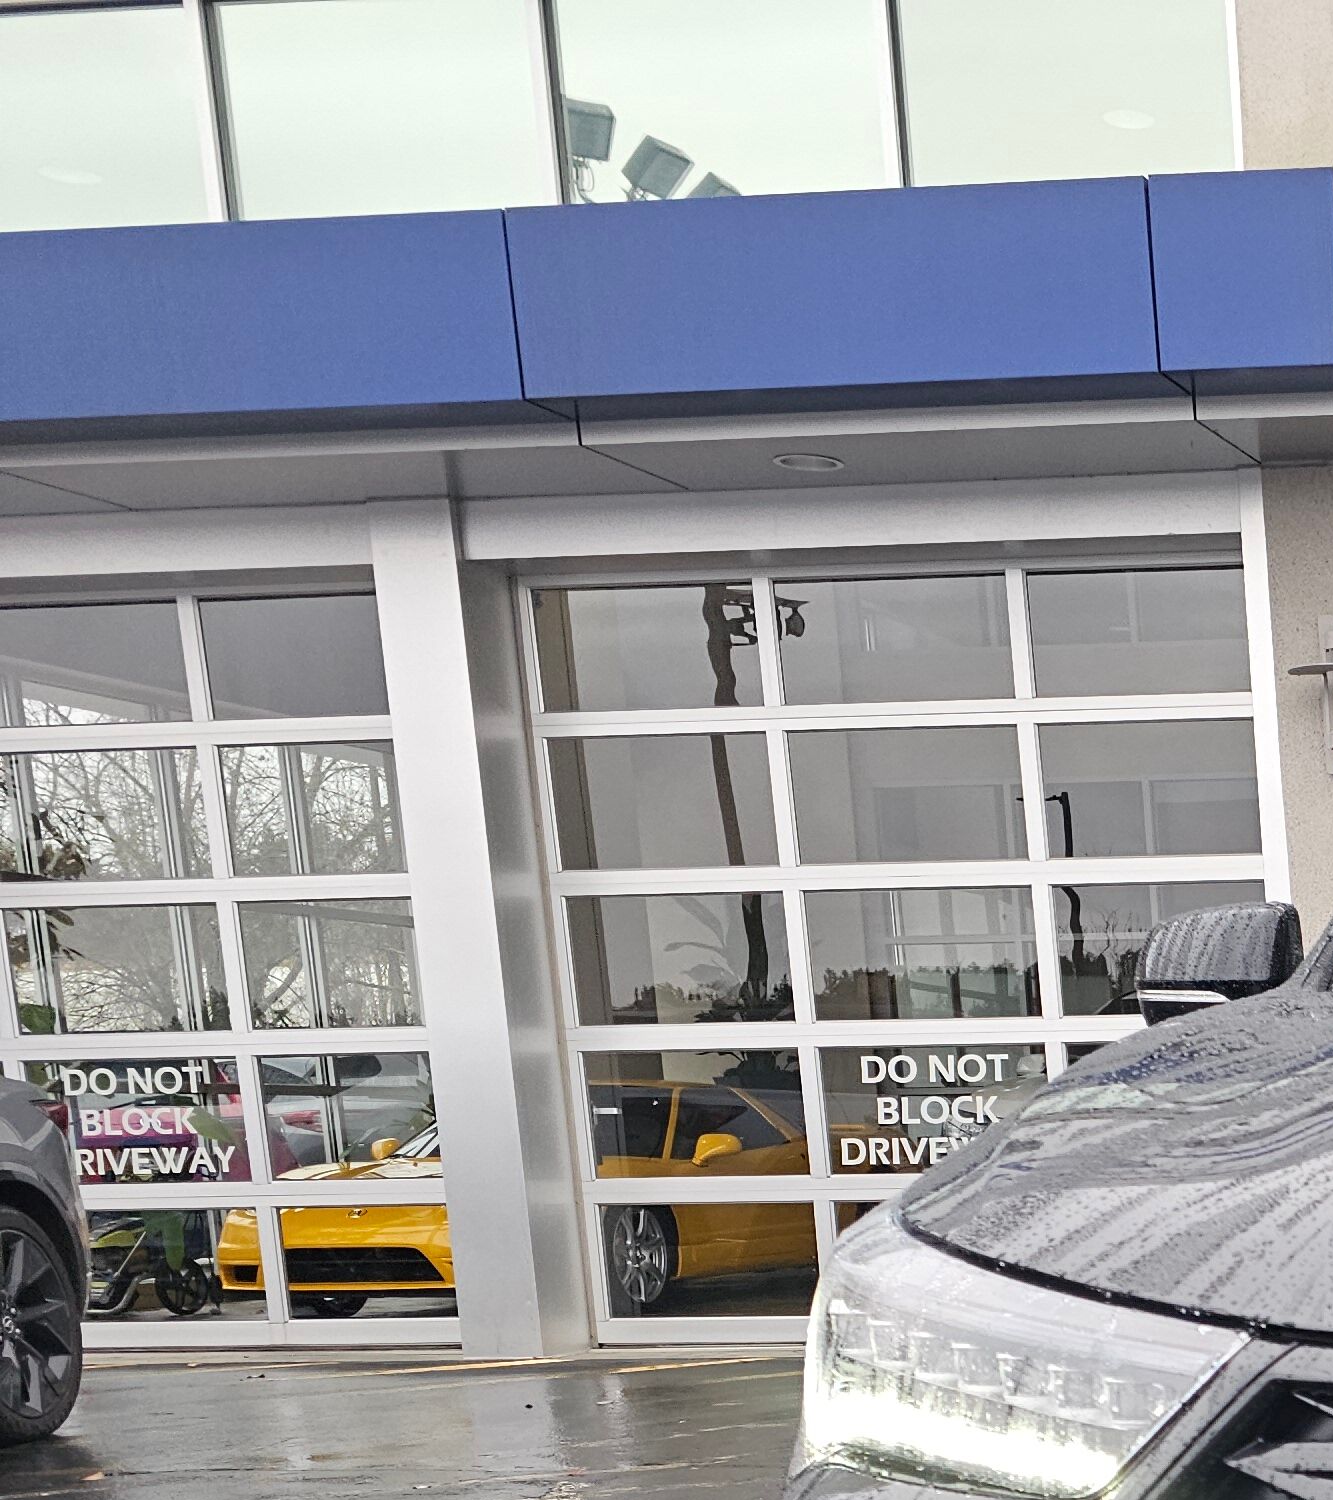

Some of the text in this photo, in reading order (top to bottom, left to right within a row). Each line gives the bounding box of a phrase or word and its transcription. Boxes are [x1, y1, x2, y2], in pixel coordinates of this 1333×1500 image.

[64, 1066, 203, 1096] DO NOT
[860, 1054, 1009, 1084] DO NOT
[80, 1107, 198, 1136] BLOCK
[877, 1095, 1000, 1125] BLOCK
[75, 1146, 235, 1176] RIVEWAY
[841, 1136, 976, 1166] DRIVE
